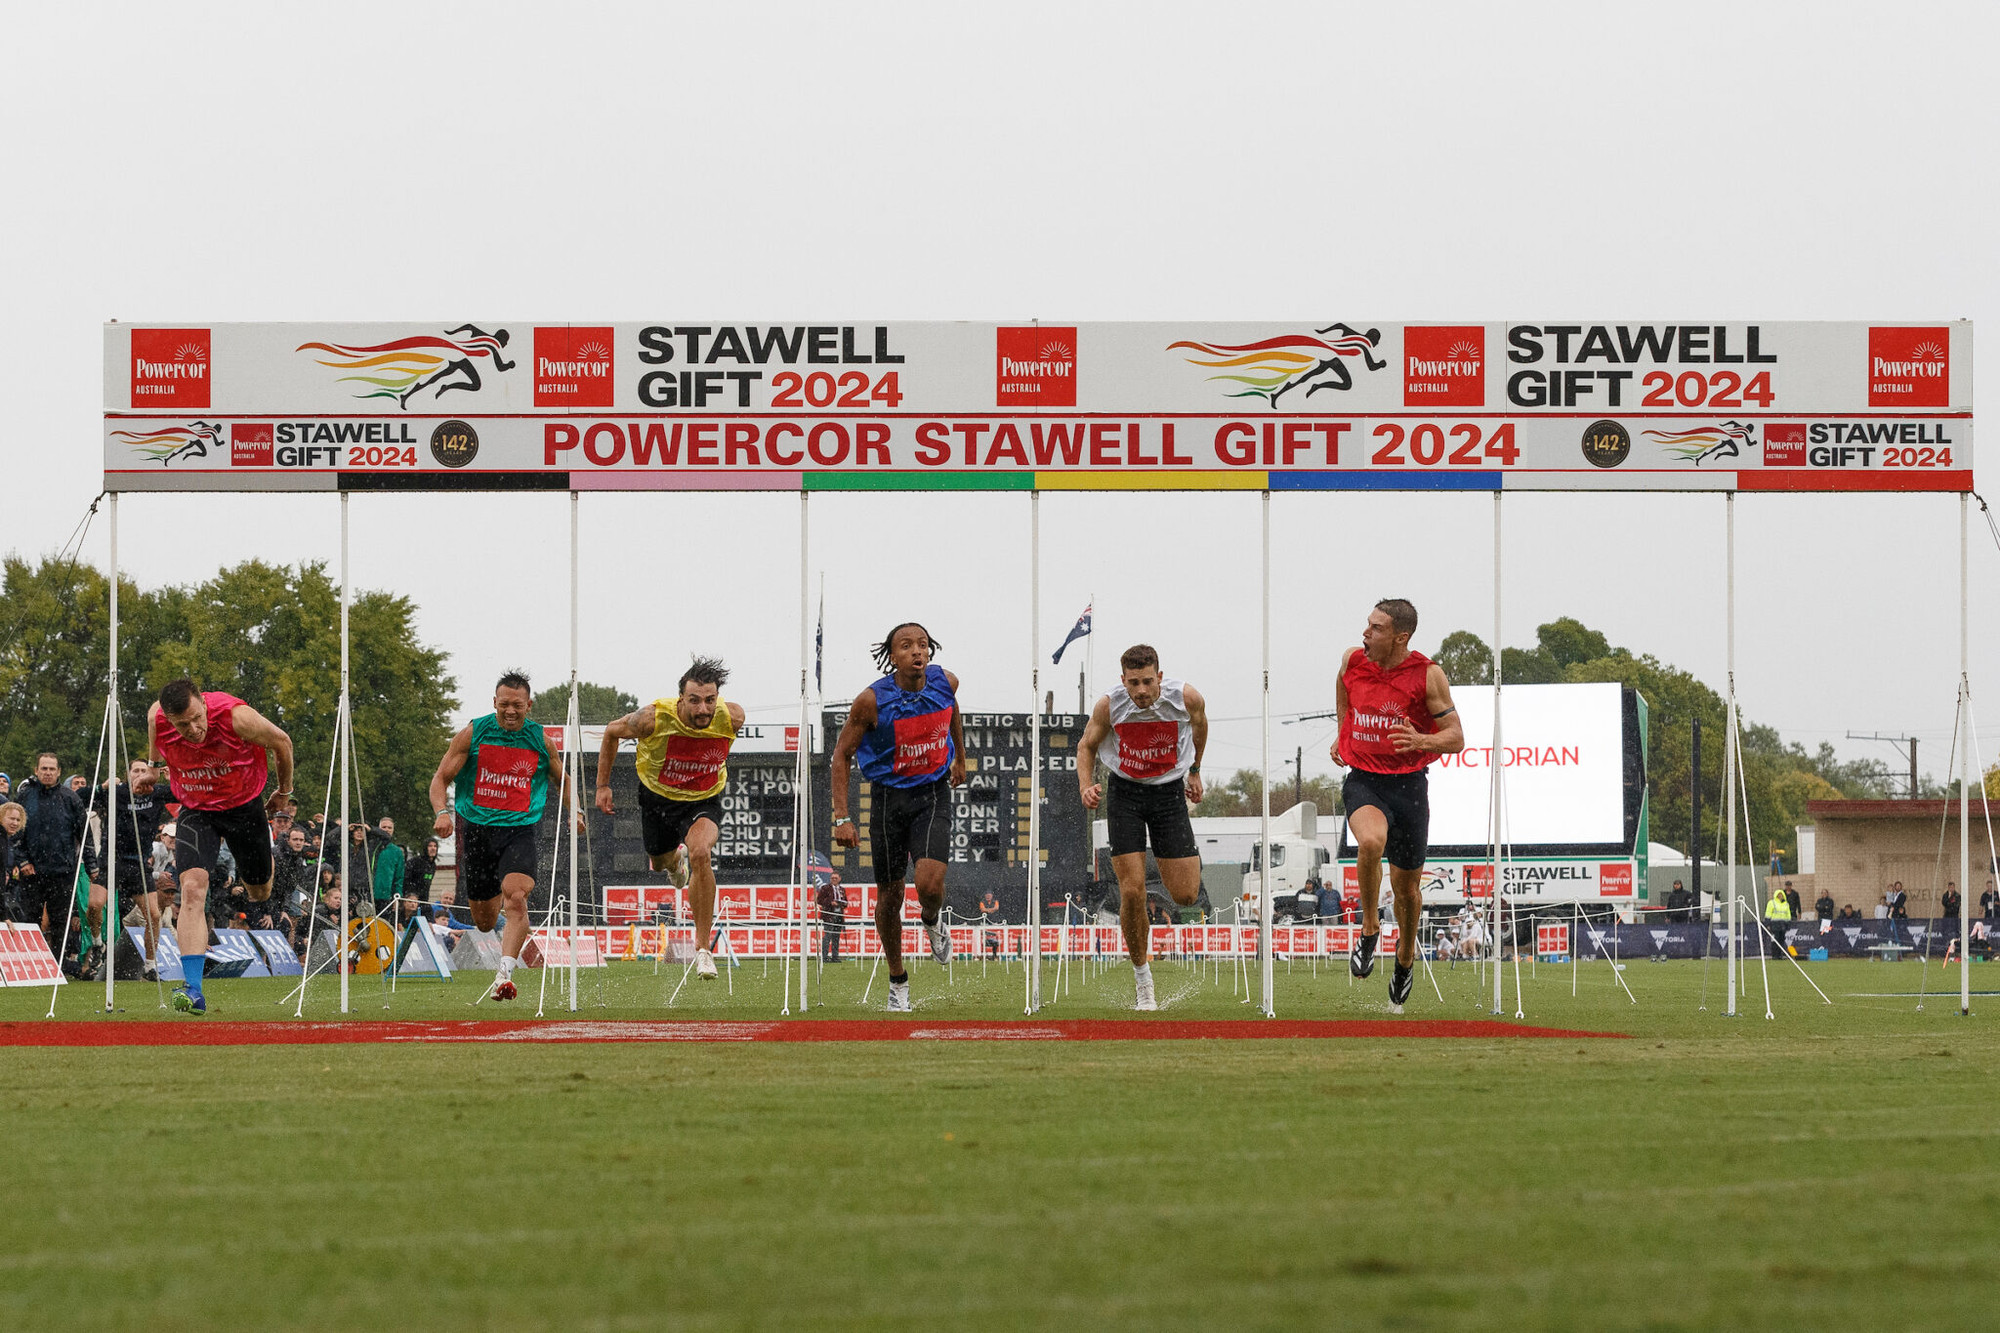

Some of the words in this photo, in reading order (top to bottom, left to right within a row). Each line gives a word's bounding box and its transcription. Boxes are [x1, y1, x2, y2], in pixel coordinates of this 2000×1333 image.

[638, 326, 905, 364] STAWELL
[1508, 326, 1777, 363] STAWELL
[136, 358, 207, 379] Powercor
[539, 357, 610, 377] Powercor
[1002, 356, 1073, 377] Powercor
[1409, 356, 1480, 377] Powercor
[1873, 356, 1945, 377] Powercor
[136, 385, 175, 394] AUSTRALIA
[538, 384, 578, 394] AUSTRALIA
[638, 371, 762, 407] GIFT
[771, 371, 904, 407] 2024
[1001, 383, 1041, 393] AUSTRALIA
[1408, 383, 1449, 393] AUSTRALIA
[1507, 370, 1633, 407] GIFT
[1641, 371, 1776, 407] 2024
[1873, 383, 1913, 393] AUSTRALIA
[277, 423, 417, 443] STAWELL
[1810, 424, 1952, 444] STAWELL
[234, 439, 272, 450] Powercor
[442, 434, 468, 451] 142
[545, 423, 891, 466] POWERCOR
[914, 422, 1193, 466] STAWELL
[1214, 422, 1352, 466] GIFT
[1371, 424, 1521, 466] 2024
[1594, 434, 1619, 451] 142
[1766, 439, 1805, 451] Powercor
[276, 447, 342, 466] GIFT
[348, 447, 418, 466] 2024
[1810, 447, 1876, 467] GIFT
[1883, 448, 1953, 467] 2024
[962, 714, 1014, 728] LETIC
[737, 727, 765, 739] ELL
[1439, 746, 1579, 768] VICTORIAN
[479, 767, 531, 789] Powercor
[738, 768, 800, 781] FINAL
[476, 787, 508, 799] AUSTRALIA
[721, 796, 750, 810] ON
[956, 805, 998, 818] ONN
[721, 811, 761, 825] ARD
[1503, 867, 1592, 880] STAWELL
[1601, 875, 1631, 885] Powercor
[1503, 882, 1545, 895] GIFT
